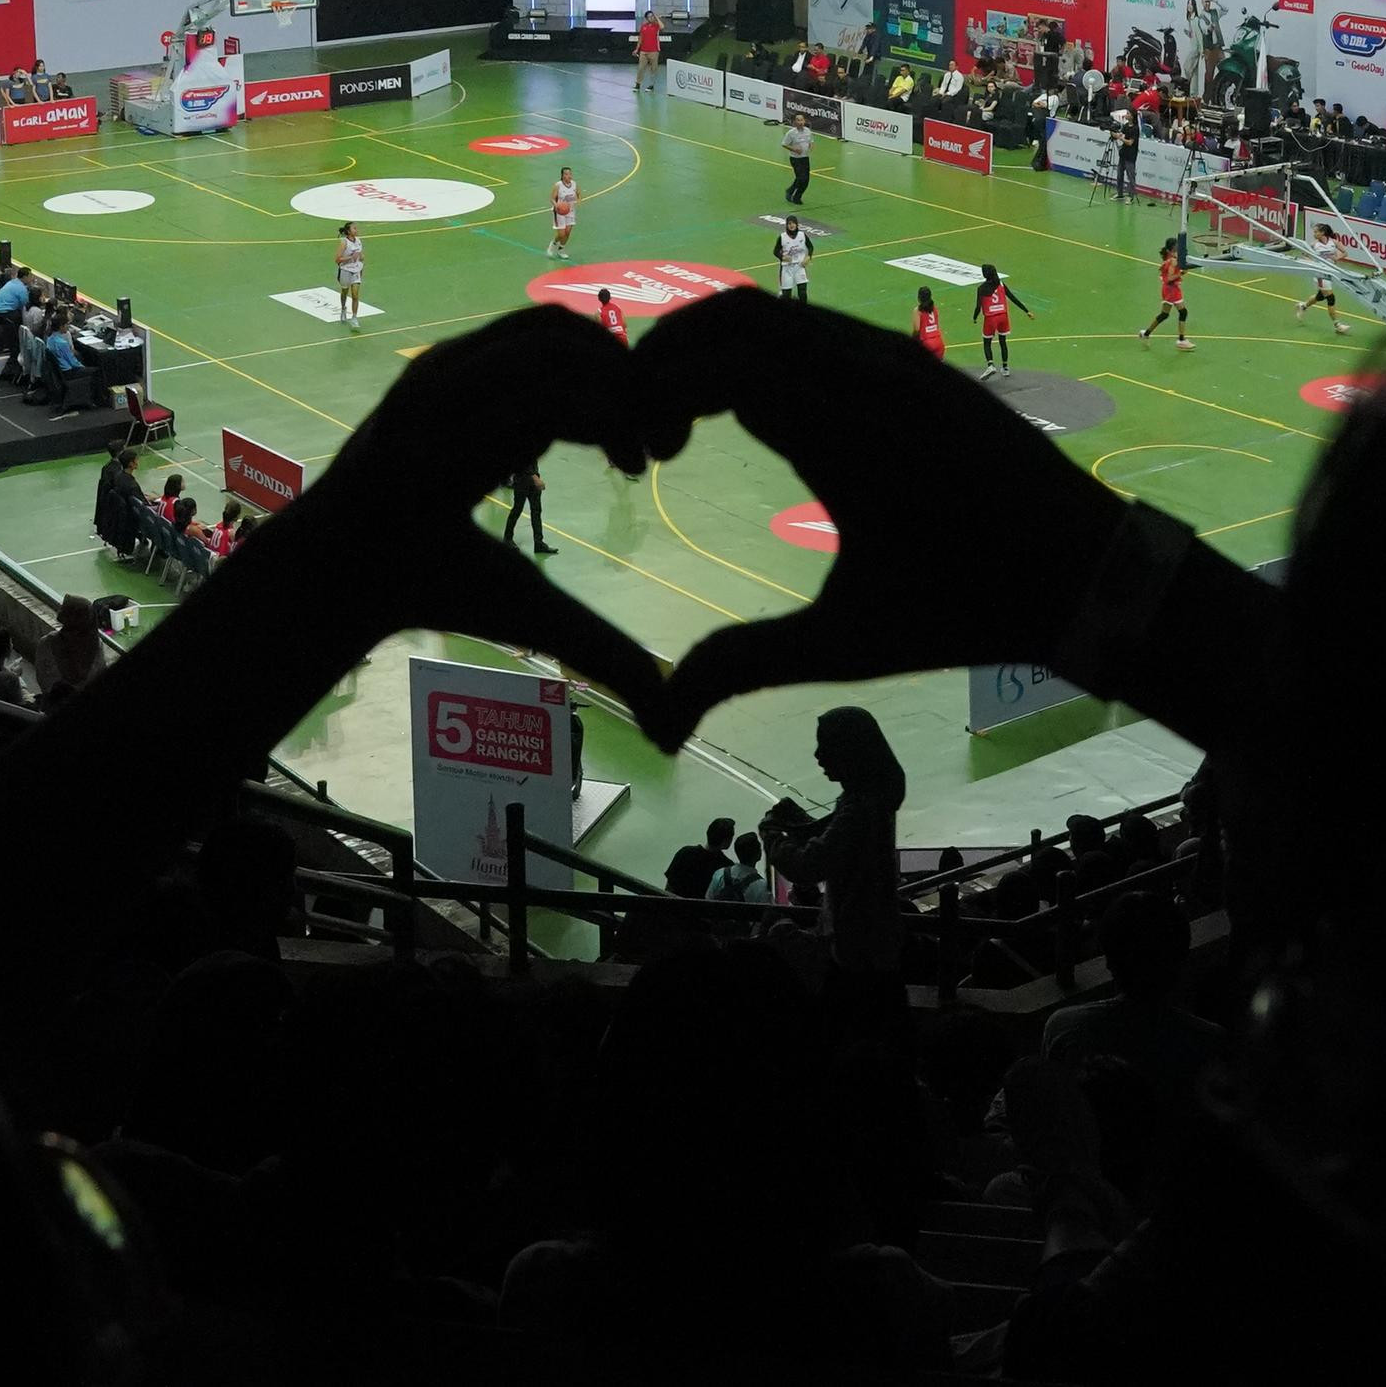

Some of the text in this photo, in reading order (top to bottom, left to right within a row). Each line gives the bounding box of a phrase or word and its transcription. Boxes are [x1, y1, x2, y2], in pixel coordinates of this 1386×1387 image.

[1349, 35, 1368, 48] DBL
[377, 77, 403, 90] MEN
[698, 74, 714, 87] UAD
[266, 89, 325, 104] HONDA
[856, 117, 900, 134] DISWAY.ID
[928, 136, 941, 149] One
[622, 270, 703, 300] HONDA
[608, 309, 617, 325] 8
[243, 464, 295, 500] HONDA
[435, 700, 543, 754] 5 TAHUN
[475, 728, 544, 751] GARANSI
[476, 744, 542, 765] RANGKA
